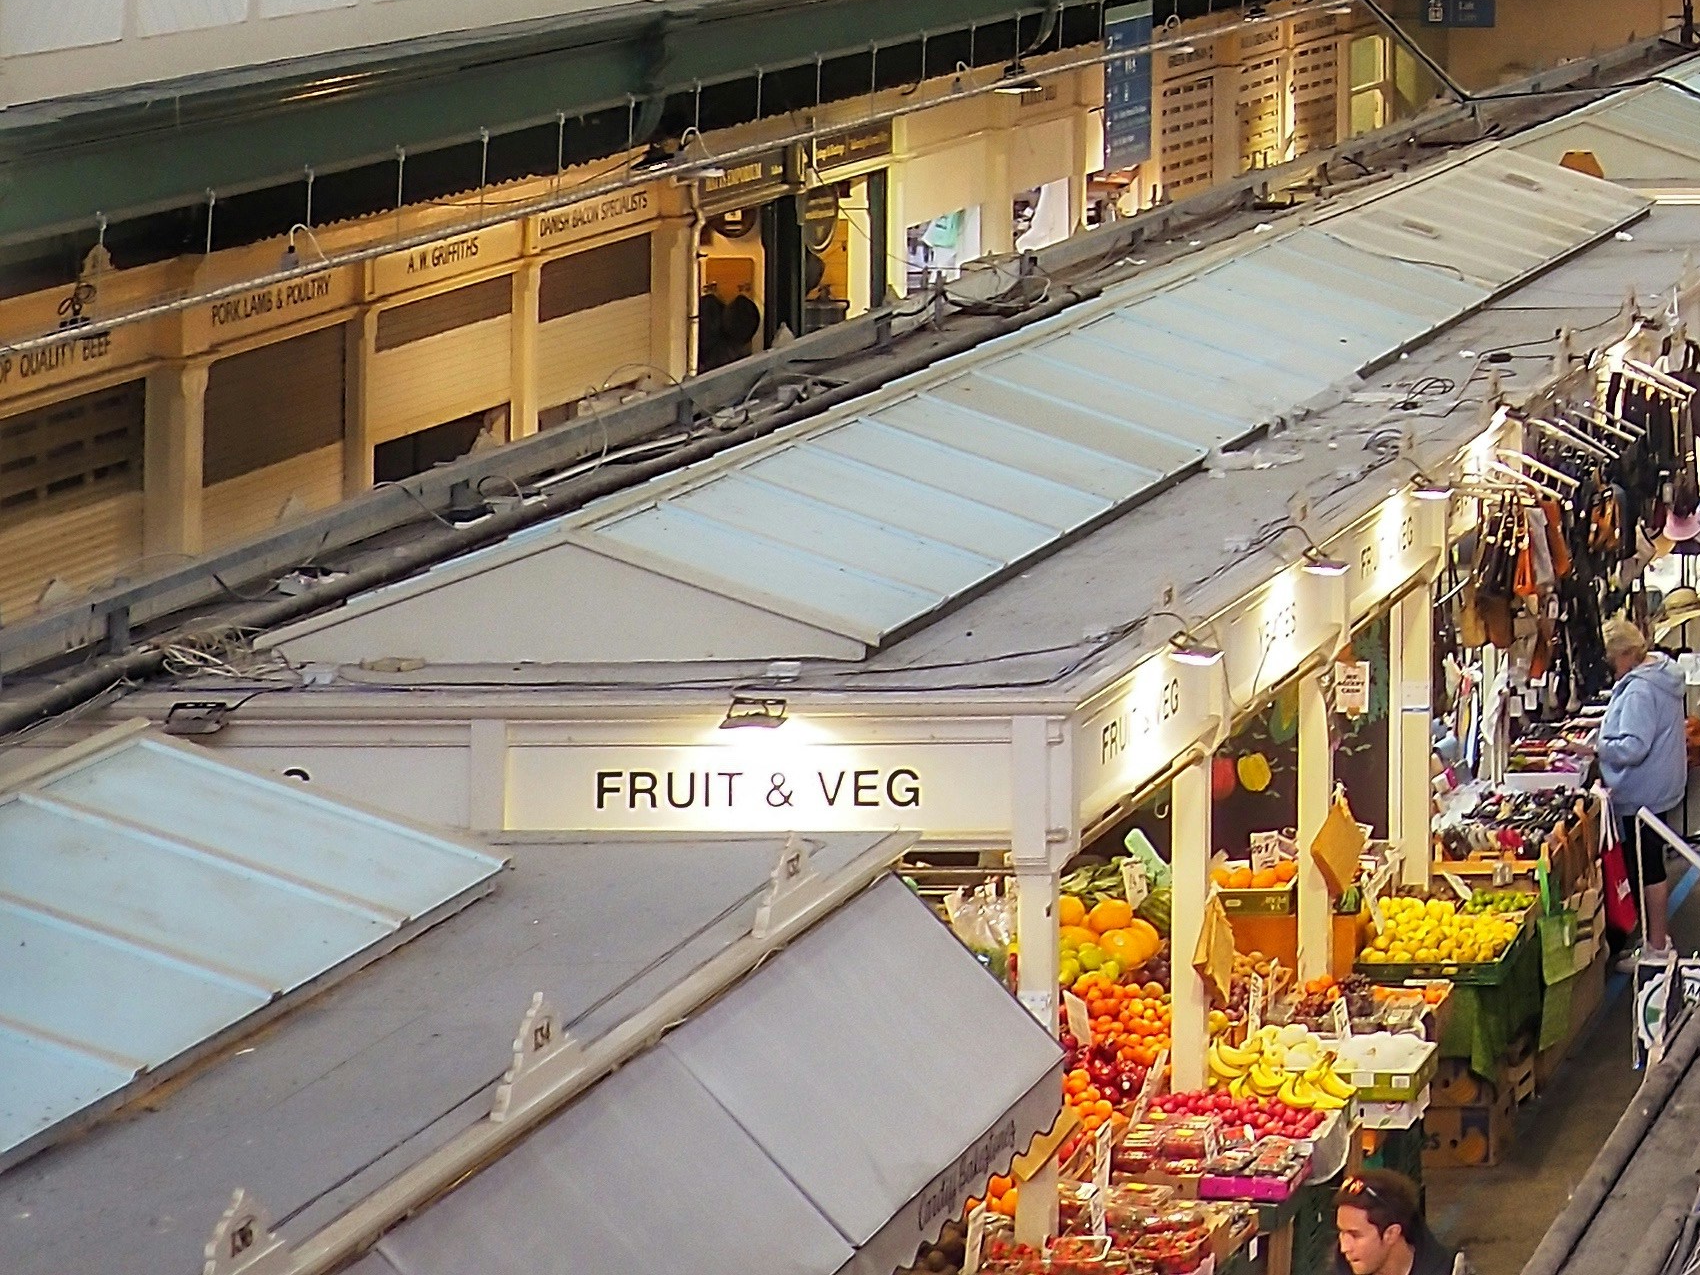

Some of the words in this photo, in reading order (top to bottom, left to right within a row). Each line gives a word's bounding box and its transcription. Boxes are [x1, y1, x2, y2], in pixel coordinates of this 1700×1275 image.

[539, 216, 569, 238] DANISH
[600, 189, 648, 221] SPECIALISTS
[431, 235, 479, 268] GRIFFITHS
[286, 273, 333, 308] POULTRY
[20, 335, 77, 379] QUALITY
[82, 331, 112, 362] BEEF
[596, 770, 744, 809] FRUIT
[765, 771, 794, 808] &
[816, 768, 921, 808] VEG
